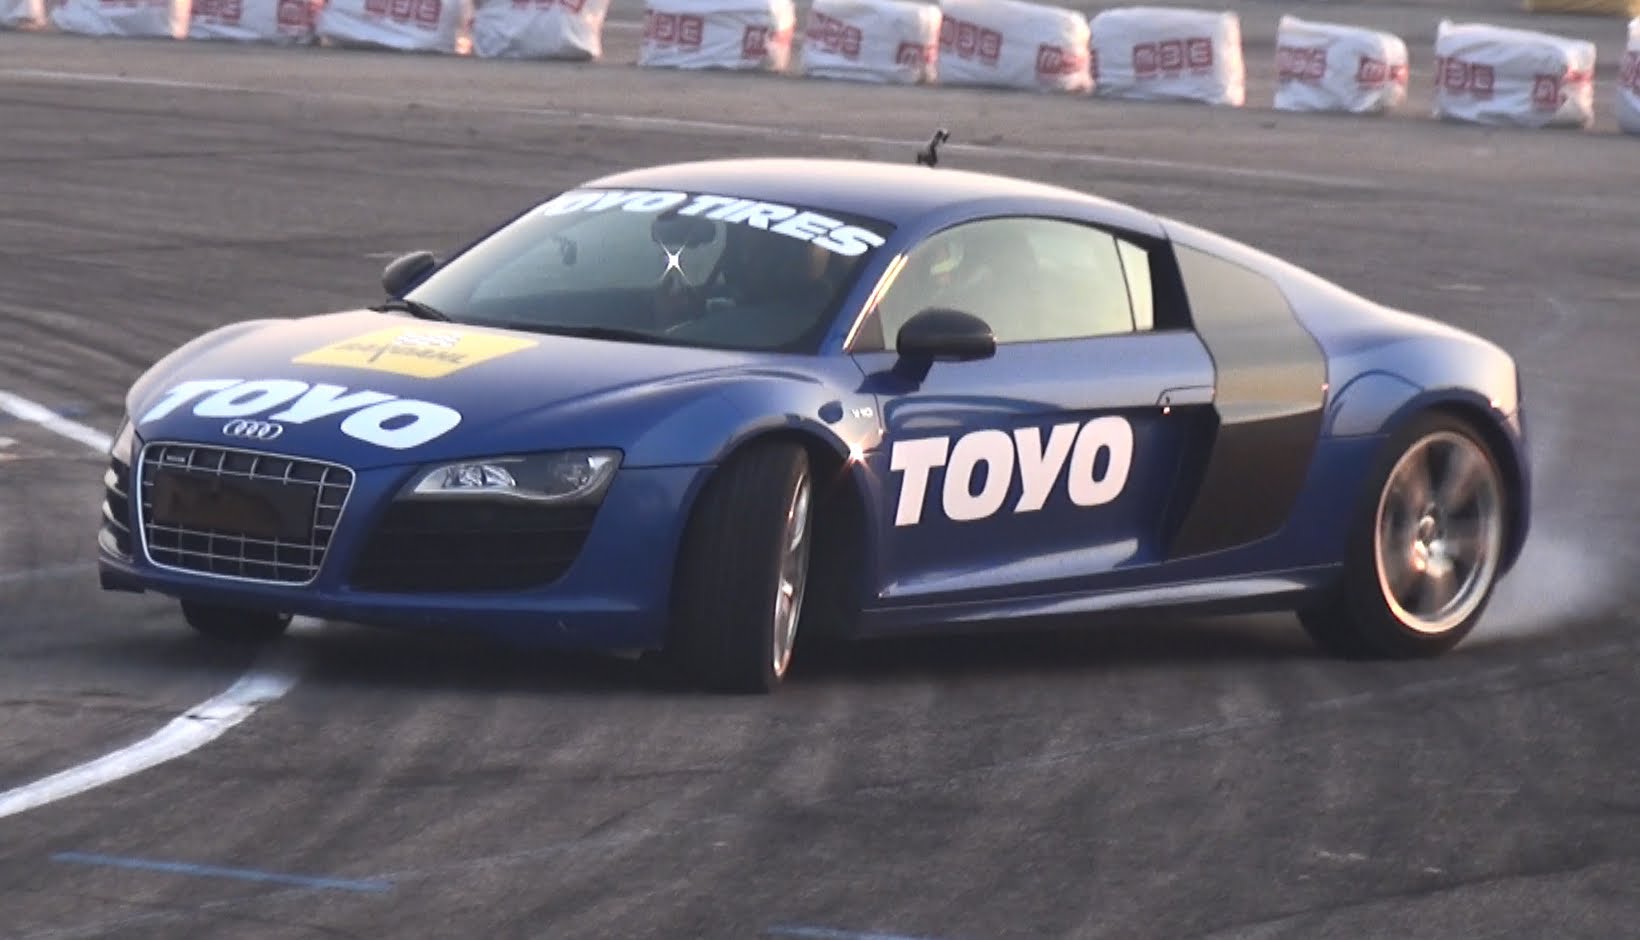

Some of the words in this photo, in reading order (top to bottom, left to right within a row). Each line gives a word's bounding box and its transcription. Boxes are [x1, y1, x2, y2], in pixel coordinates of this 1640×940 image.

[540, 190, 687, 216] OYO
[677, 194, 886, 257] TIRES
[139, 378, 463, 450] TOYO
[889, 414, 1135, 527] TOYO
